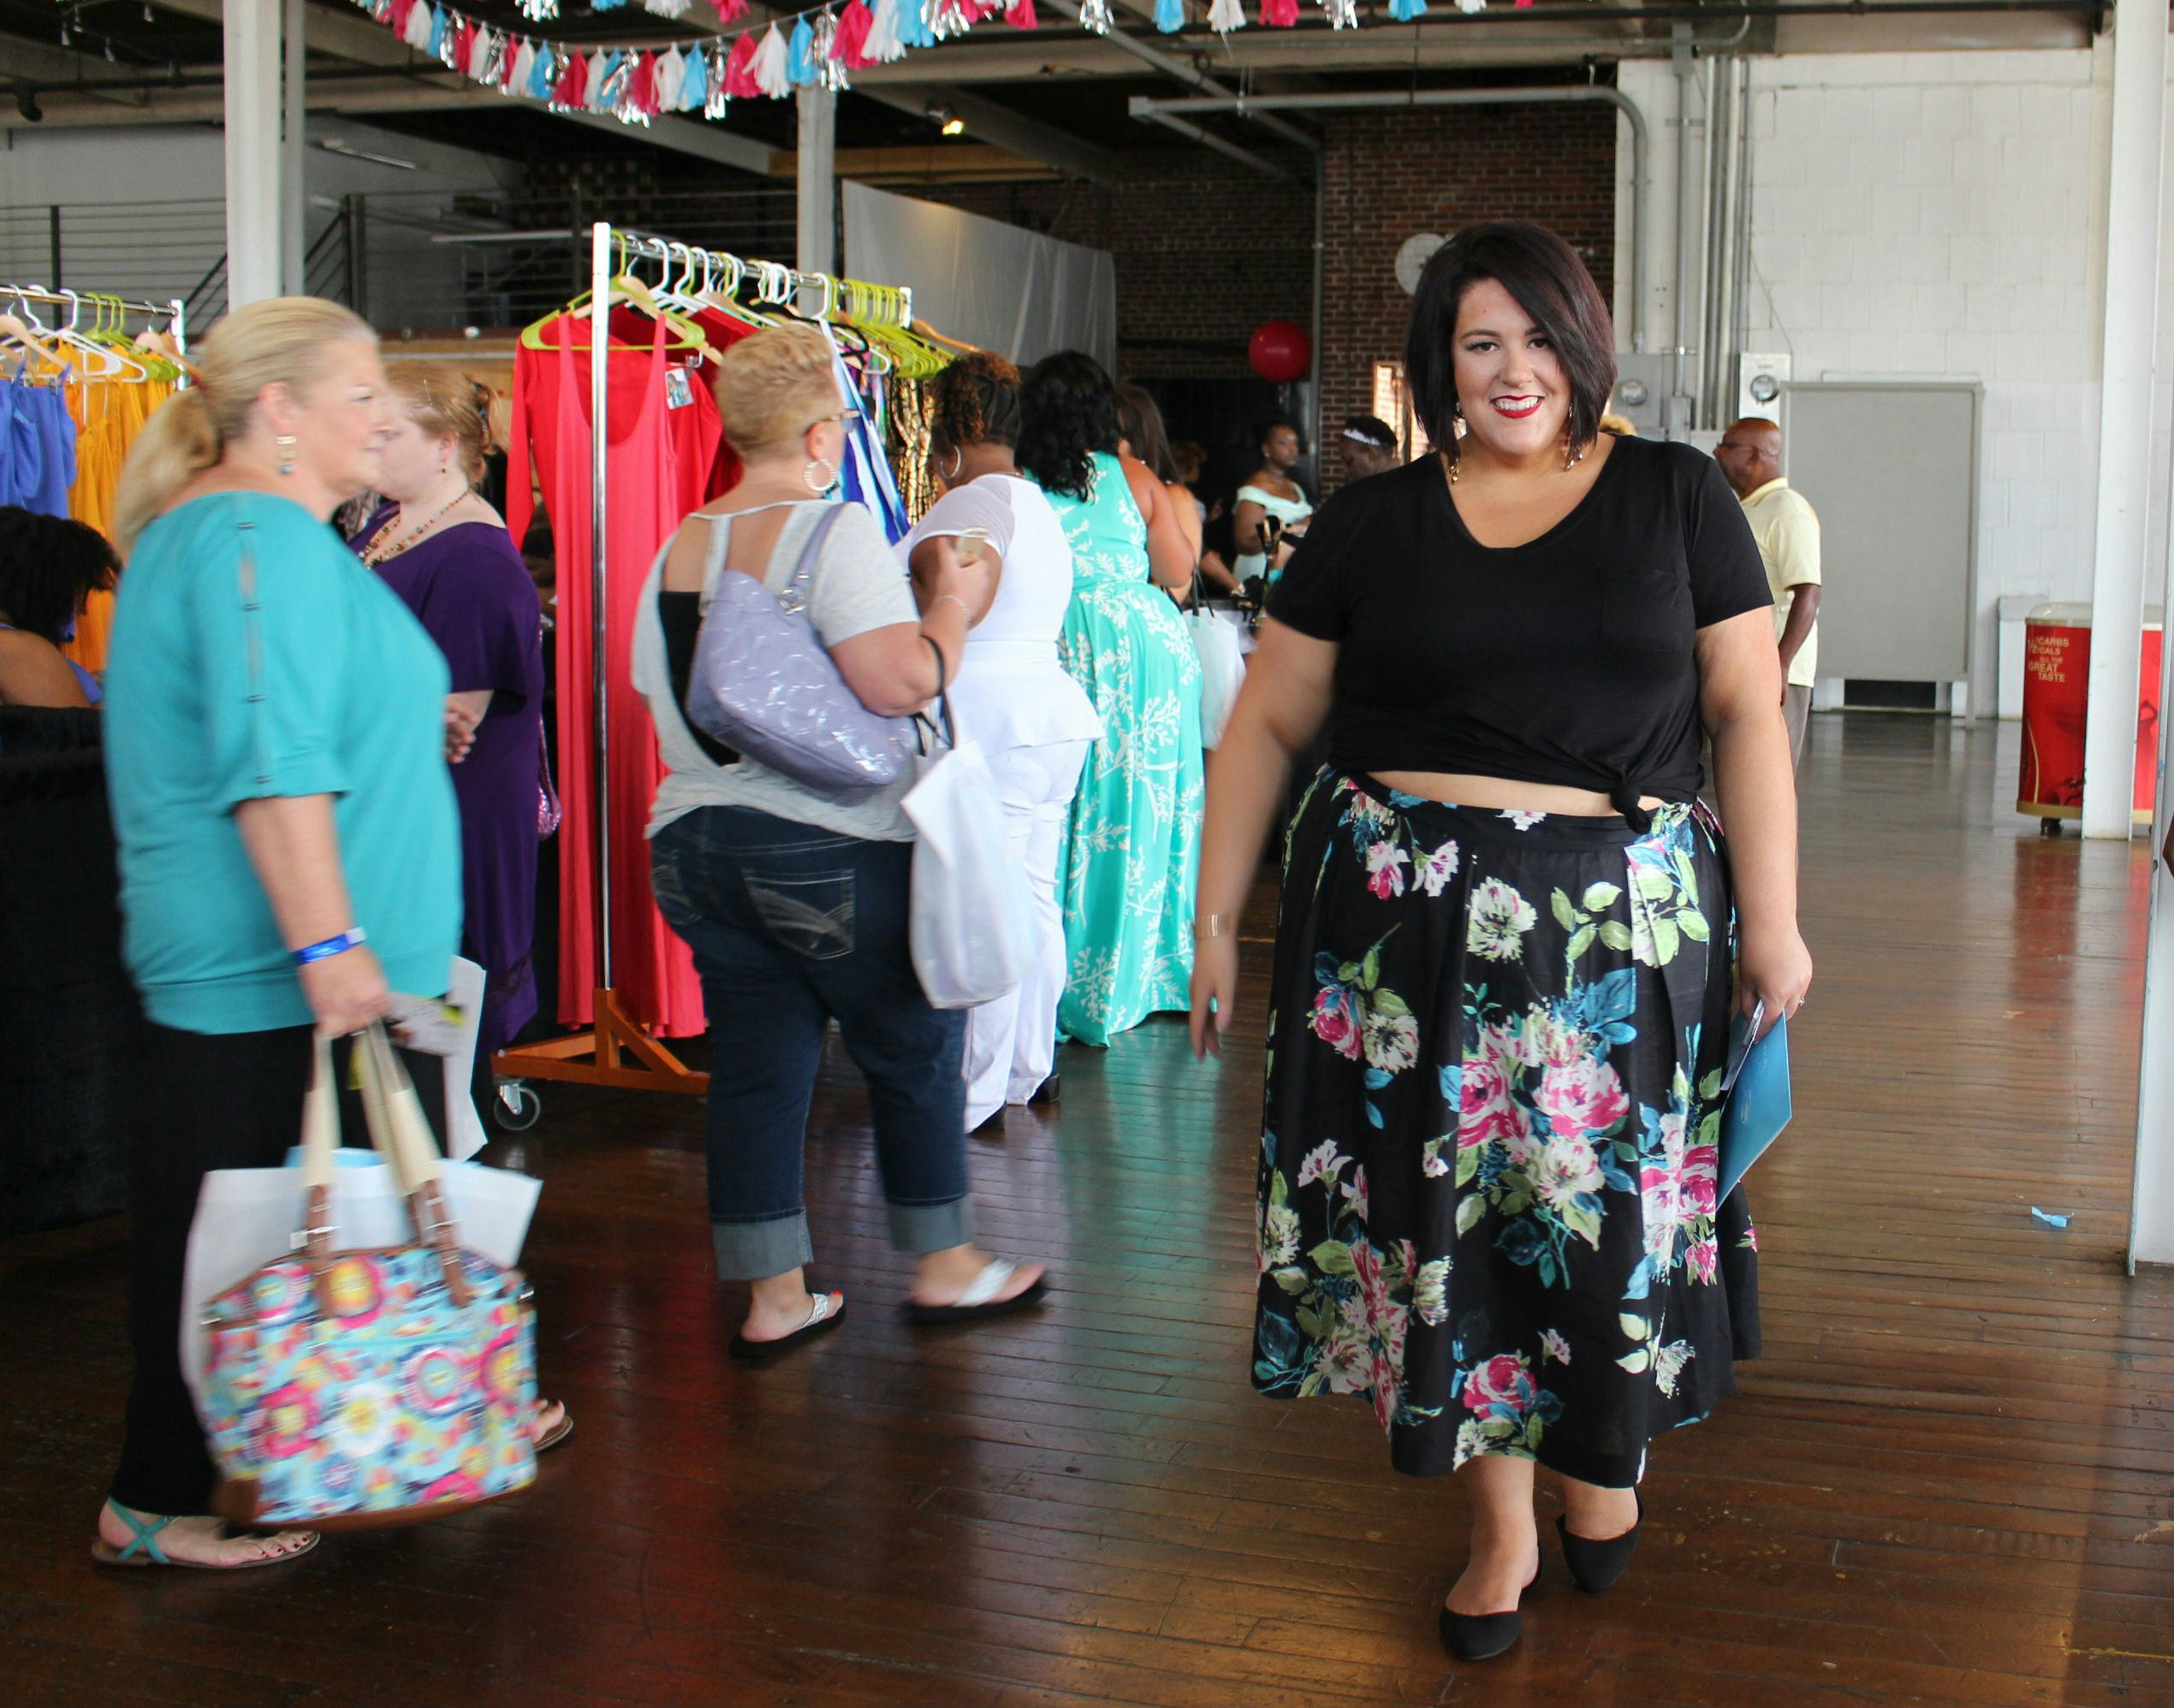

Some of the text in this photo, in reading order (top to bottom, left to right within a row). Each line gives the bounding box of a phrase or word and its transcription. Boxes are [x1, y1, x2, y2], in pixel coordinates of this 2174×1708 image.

[2039, 637, 2069, 648] CARBS
[2028, 661, 2058, 673] GREAT
[2038, 672, 2065, 682] TASTE
